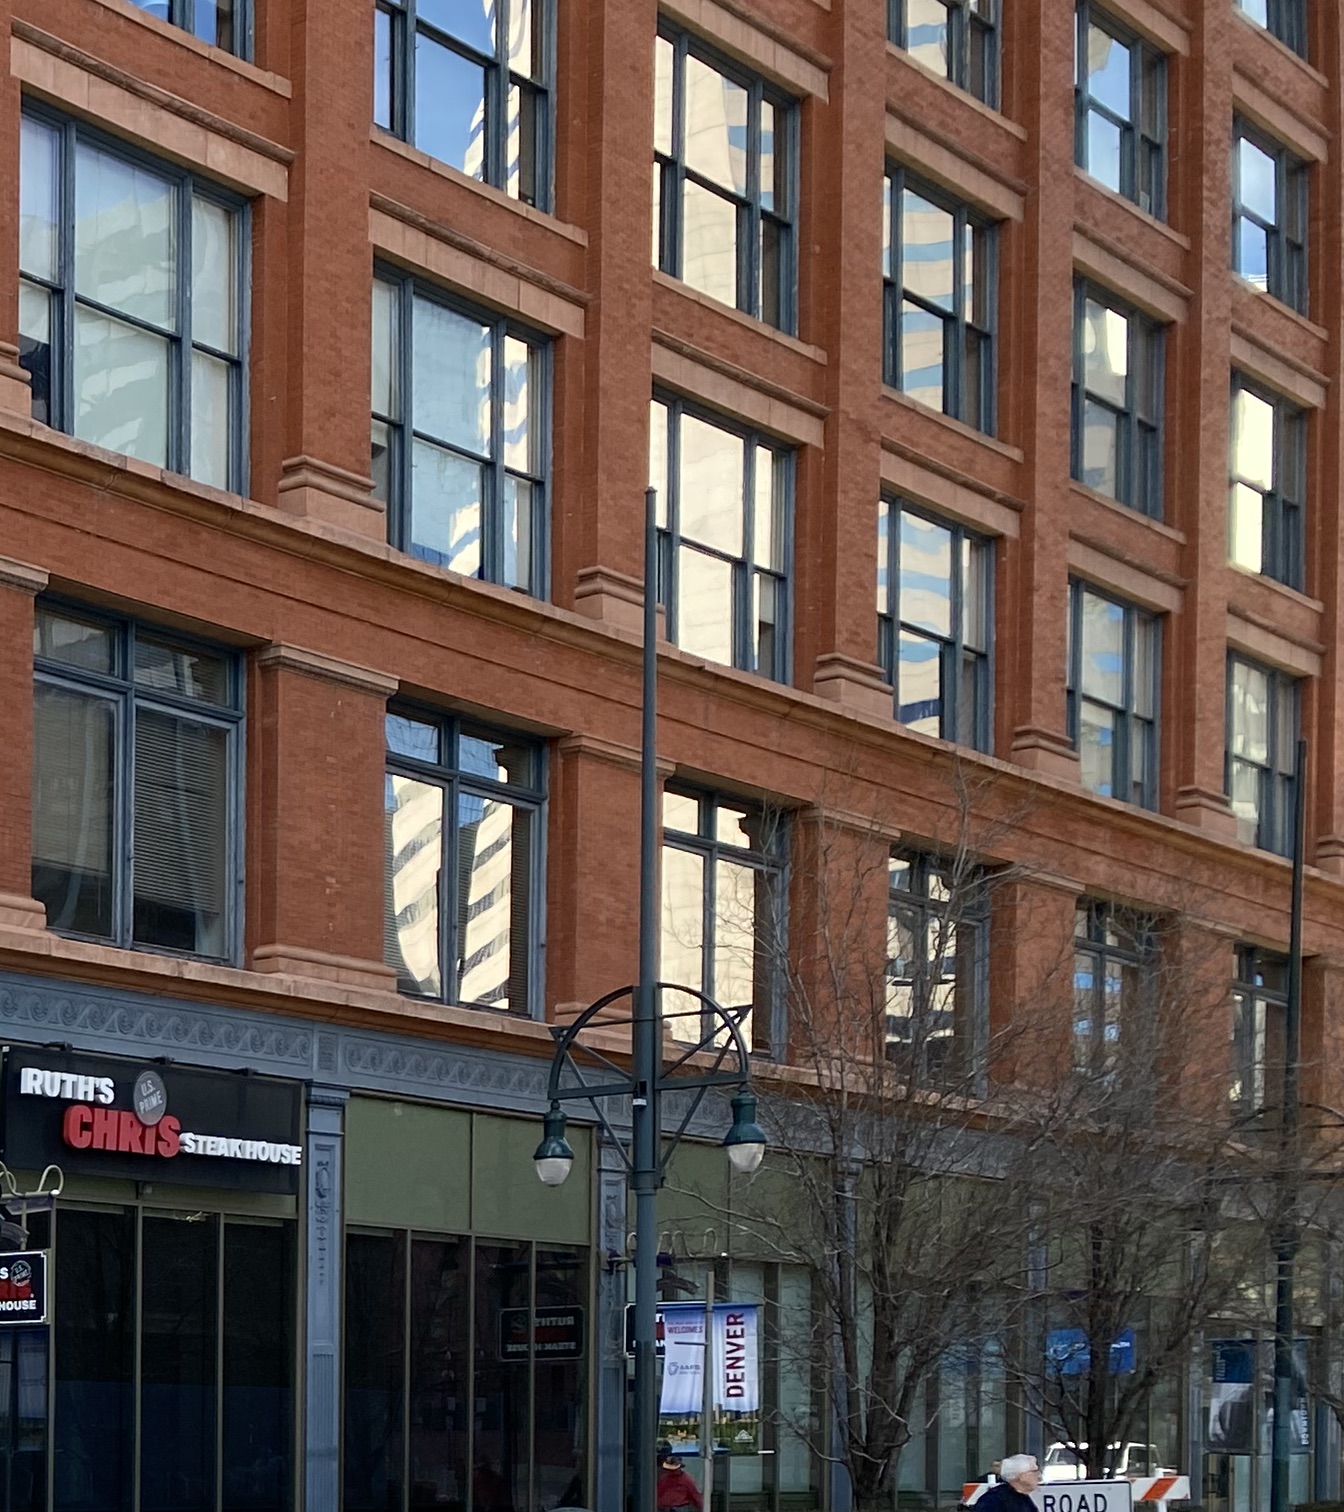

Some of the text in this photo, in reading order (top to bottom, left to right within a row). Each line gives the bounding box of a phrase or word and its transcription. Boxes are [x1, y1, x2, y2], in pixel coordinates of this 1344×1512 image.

[20, 1067, 114, 1104] RUTH'S
[139, 1090, 163, 1115] PRIME
[63, 1104, 181, 1158] CHRIS
[667, 1325, 703, 1334] WELCOMES
[726, 1312, 746, 1399] DENVER
